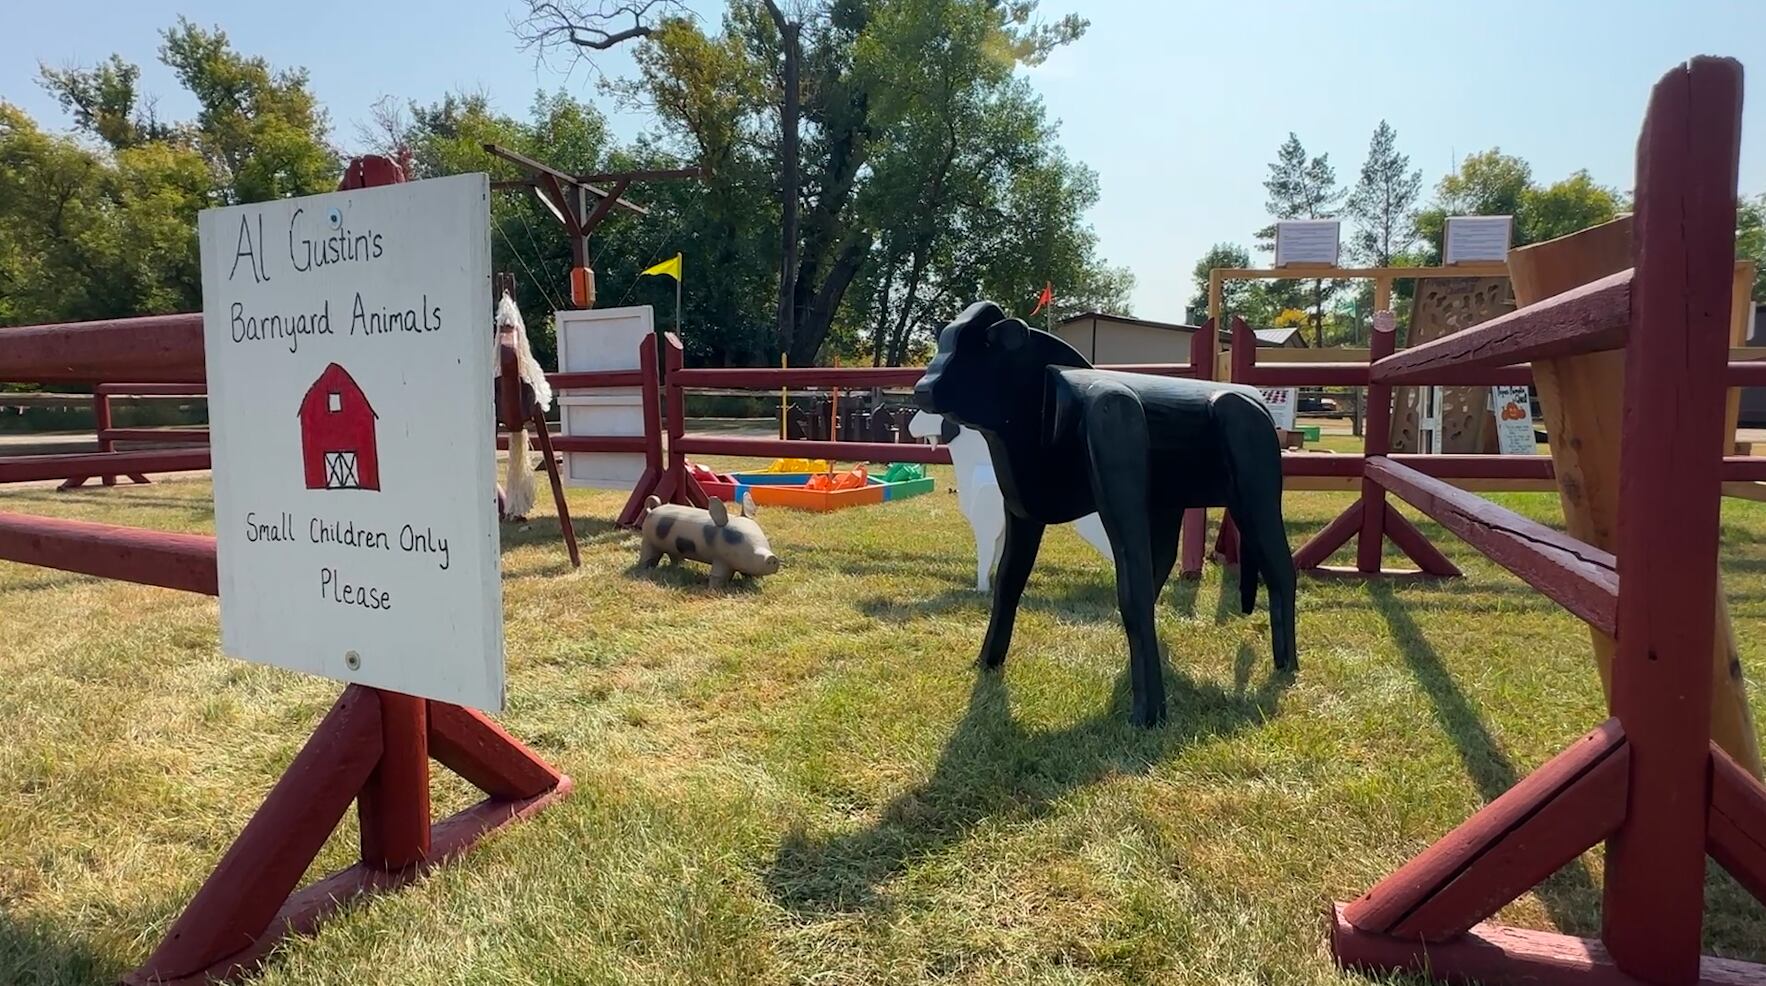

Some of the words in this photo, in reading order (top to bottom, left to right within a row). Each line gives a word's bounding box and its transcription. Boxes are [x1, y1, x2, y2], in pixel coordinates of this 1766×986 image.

[228, 213, 271, 284] Al
[289, 208, 384, 273] Gustin's
[231, 299, 333, 354] Barnyard
[351, 292, 443, 336] Animals
[247, 511, 296, 543] Small
[310, 517, 390, 551] Children
[400, 523, 450, 571] Only
[320, 567, 393, 611] Please
